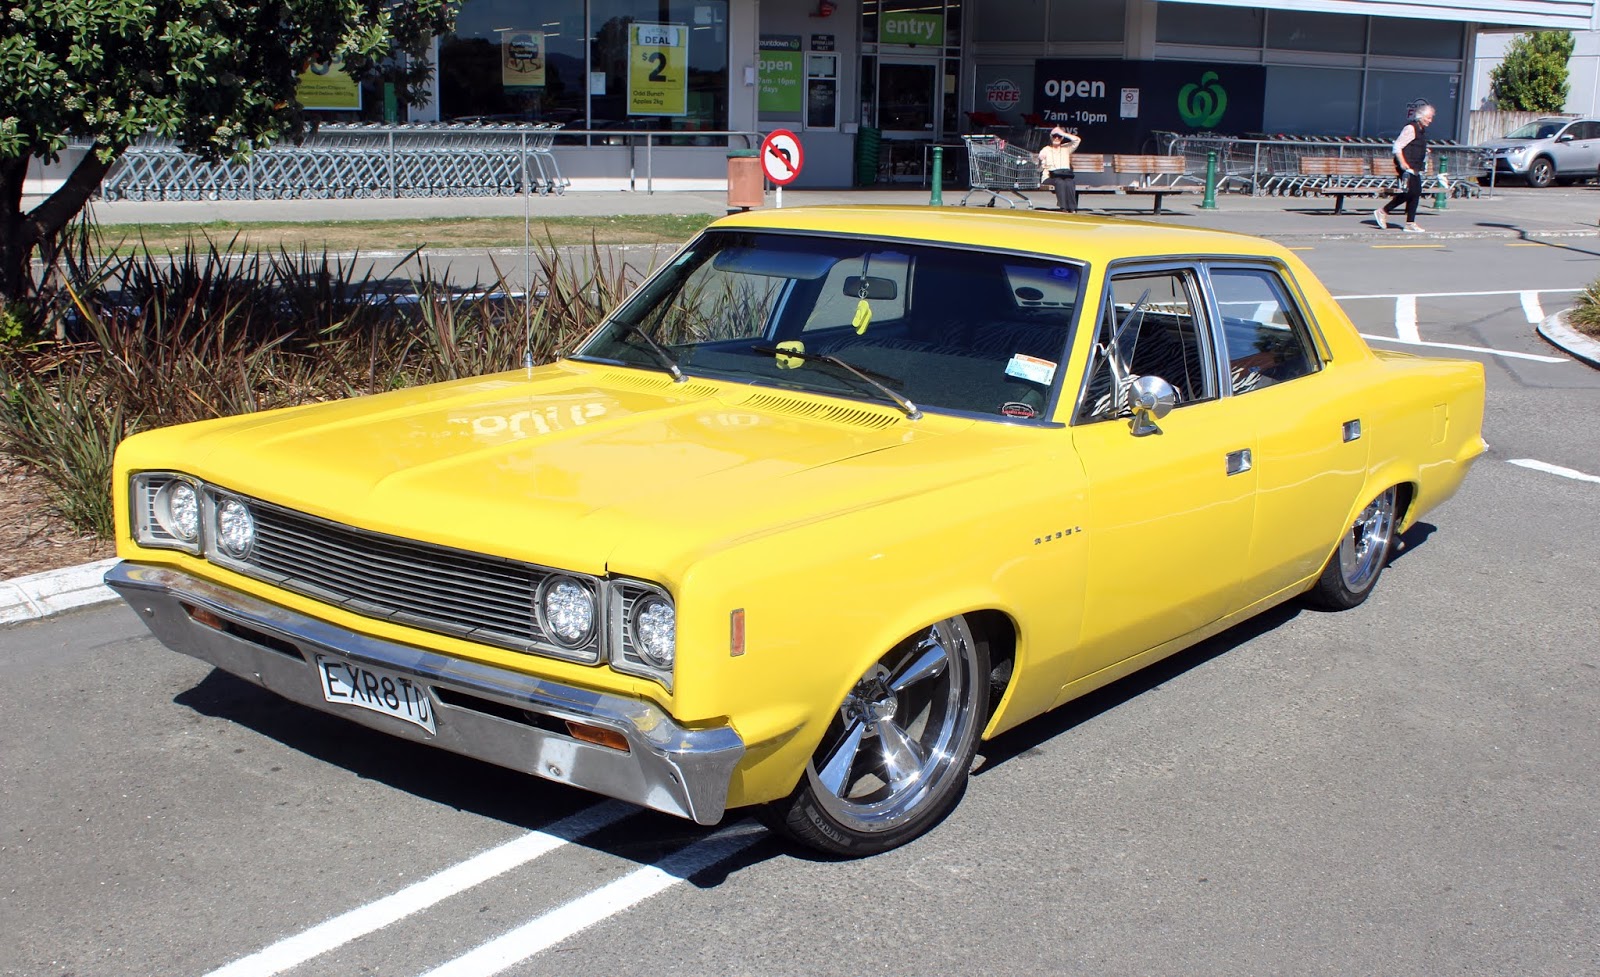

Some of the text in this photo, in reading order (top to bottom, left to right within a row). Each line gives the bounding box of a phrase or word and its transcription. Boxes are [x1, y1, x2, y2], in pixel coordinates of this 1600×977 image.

[885, 19, 936, 39] entry
[645, 36, 671, 44] DEAL
[759, 60, 792, 73] open
[778, 77, 796, 86] 10pm
[762, 85, 778, 93] days
[1044, 79, 1106, 103] open
[988, 91, 1020, 101] FREE
[1044, 110, 1068, 121] 7am
